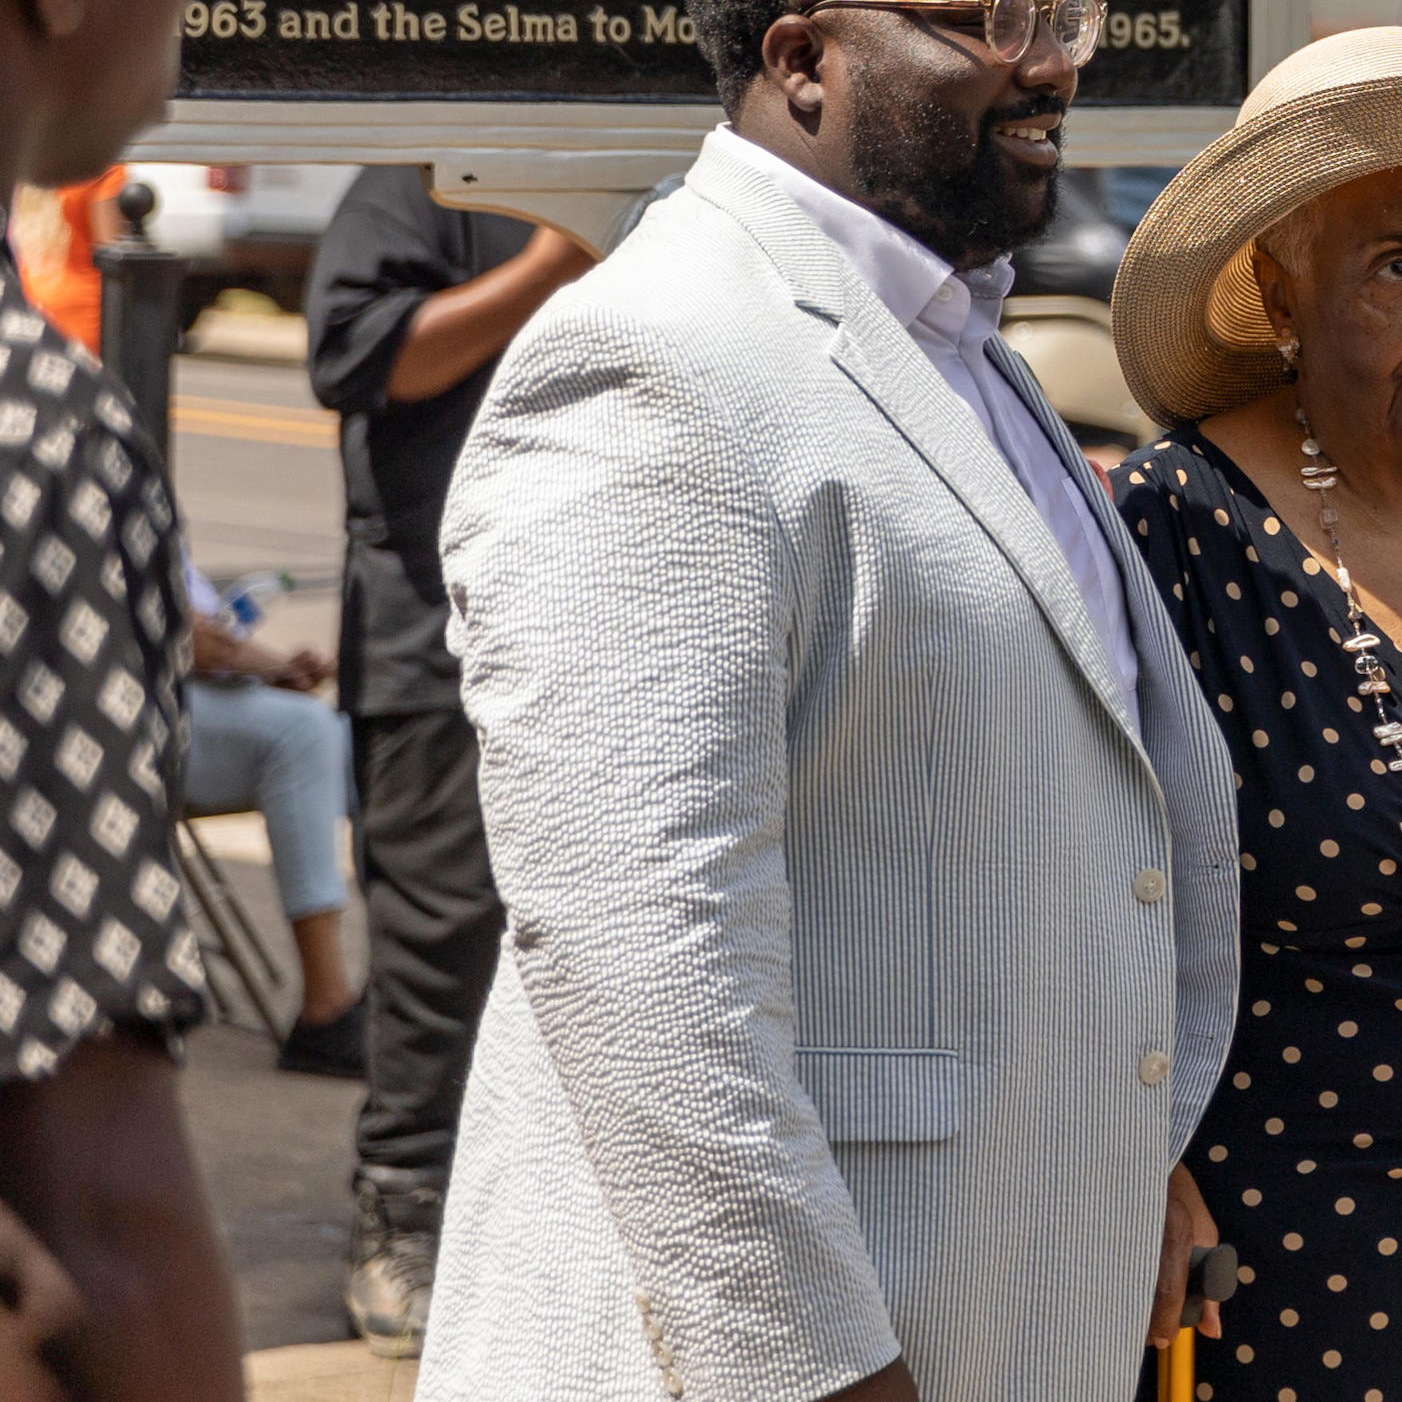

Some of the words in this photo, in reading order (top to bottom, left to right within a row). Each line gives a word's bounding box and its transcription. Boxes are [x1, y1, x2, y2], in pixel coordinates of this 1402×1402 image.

[176, 0, 267, 39] 963
[279, 2, 359, 39] and
[371, 3, 446, 40] the
[458, 4, 577, 42] Selma
[588, 6, 631, 42] to
